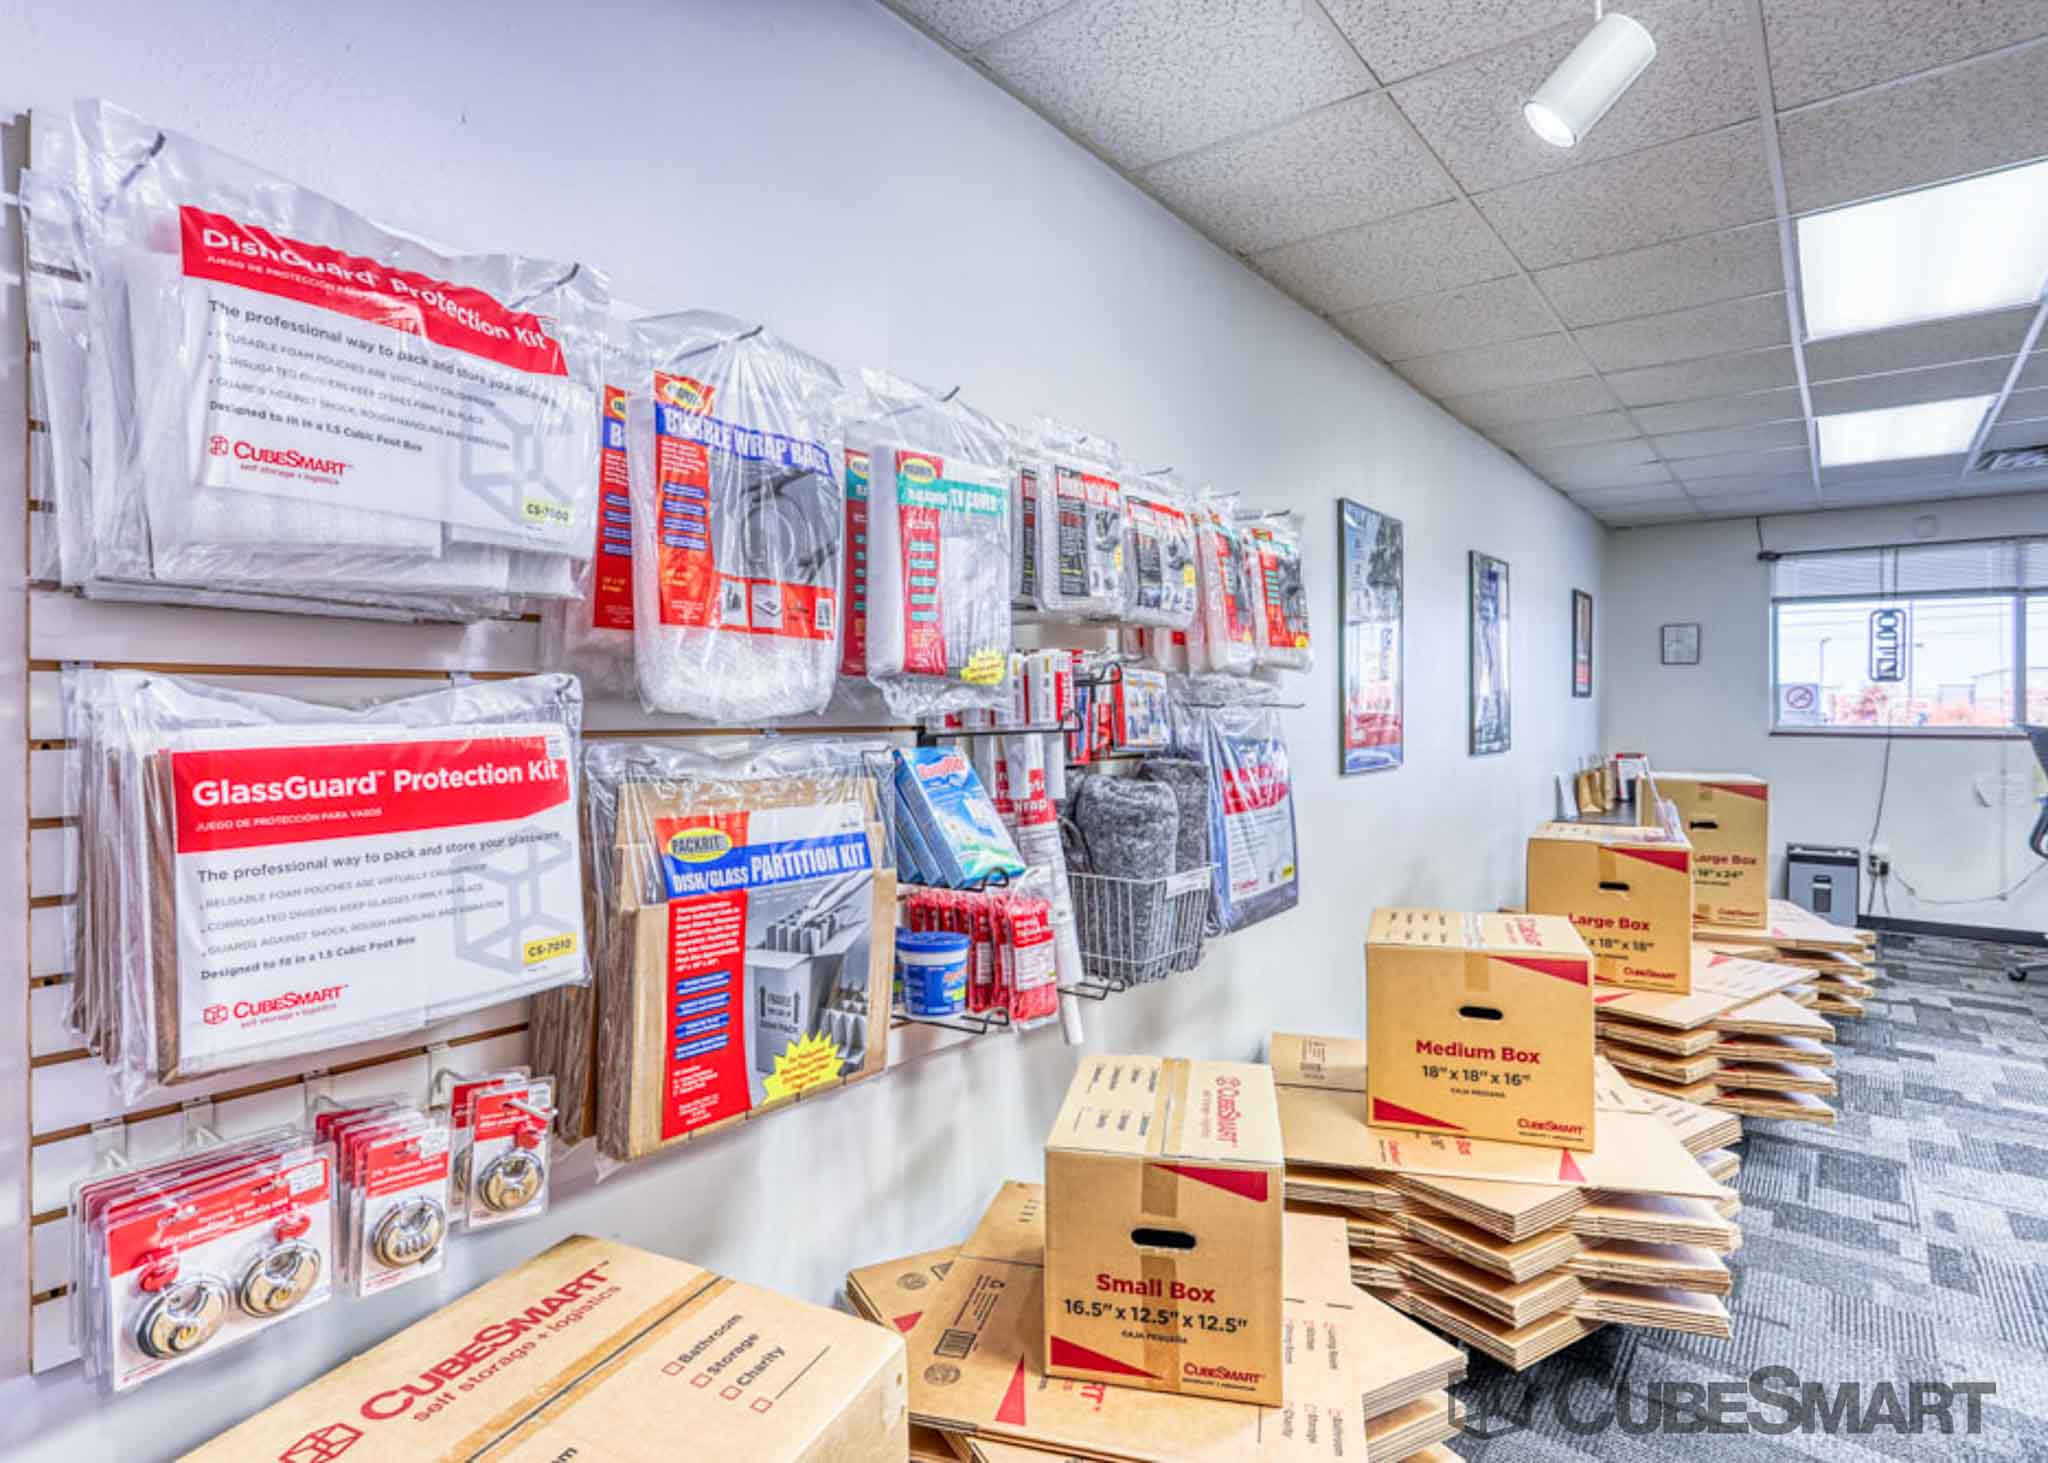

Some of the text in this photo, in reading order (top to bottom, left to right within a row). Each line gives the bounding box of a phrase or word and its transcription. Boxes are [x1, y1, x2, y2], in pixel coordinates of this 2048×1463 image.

[203, 228, 376, 288] DishGuard
[390, 278, 511, 341] Protection
[513, 326, 548, 351] Kit
[207, 299, 240, 318] The
[245, 309, 342, 343] professional
[346, 336, 376, 353] way
[378, 344, 393, 356] to
[398, 351, 429, 366] pack
[432, 359, 455, 375] and
[209, 400, 267, 420] Designed
[192, 759, 560, 808] GlassGuard Protection Kit
[196, 819, 233, 832] JUEGO
[235, 816, 250, 829] DE
[321, 810, 348, 821] PARA
[197, 869, 230, 884] The
[234, 855, 329, 882] professional
[333, 854, 361, 869] way
[364, 852, 381, 865] to
[383, 847, 417, 864] pack
[419, 844, 442, 857] and
[445, 841, 476, 855] store
[479, 838, 506, 852] your
[750, 852, 838, 882] PARTITION
[840, 842, 867, 866] KIT
[1569, 912, 1650, 933] Large Box
[201, 961, 260, 981] Designed
[263, 960, 276, 970] to
[1416, 1040, 1541, 1065] Medium Box
[1462, 1068, 1488, 1083] 18"
[1096, 1272, 1216, 1304] Small Box
[1064, 1299, 1248, 1333] 16.5" x 12.5" x 12.5"
[413, 1391, 458, 1423] self
[462, 1341, 537, 1393] storage
[550, 1285, 623, 1334] logistics
[677, 1313, 744, 1364] Bathroom
[706, 1333, 760, 1376] Storage
[736, 1345, 787, 1387] Charity
